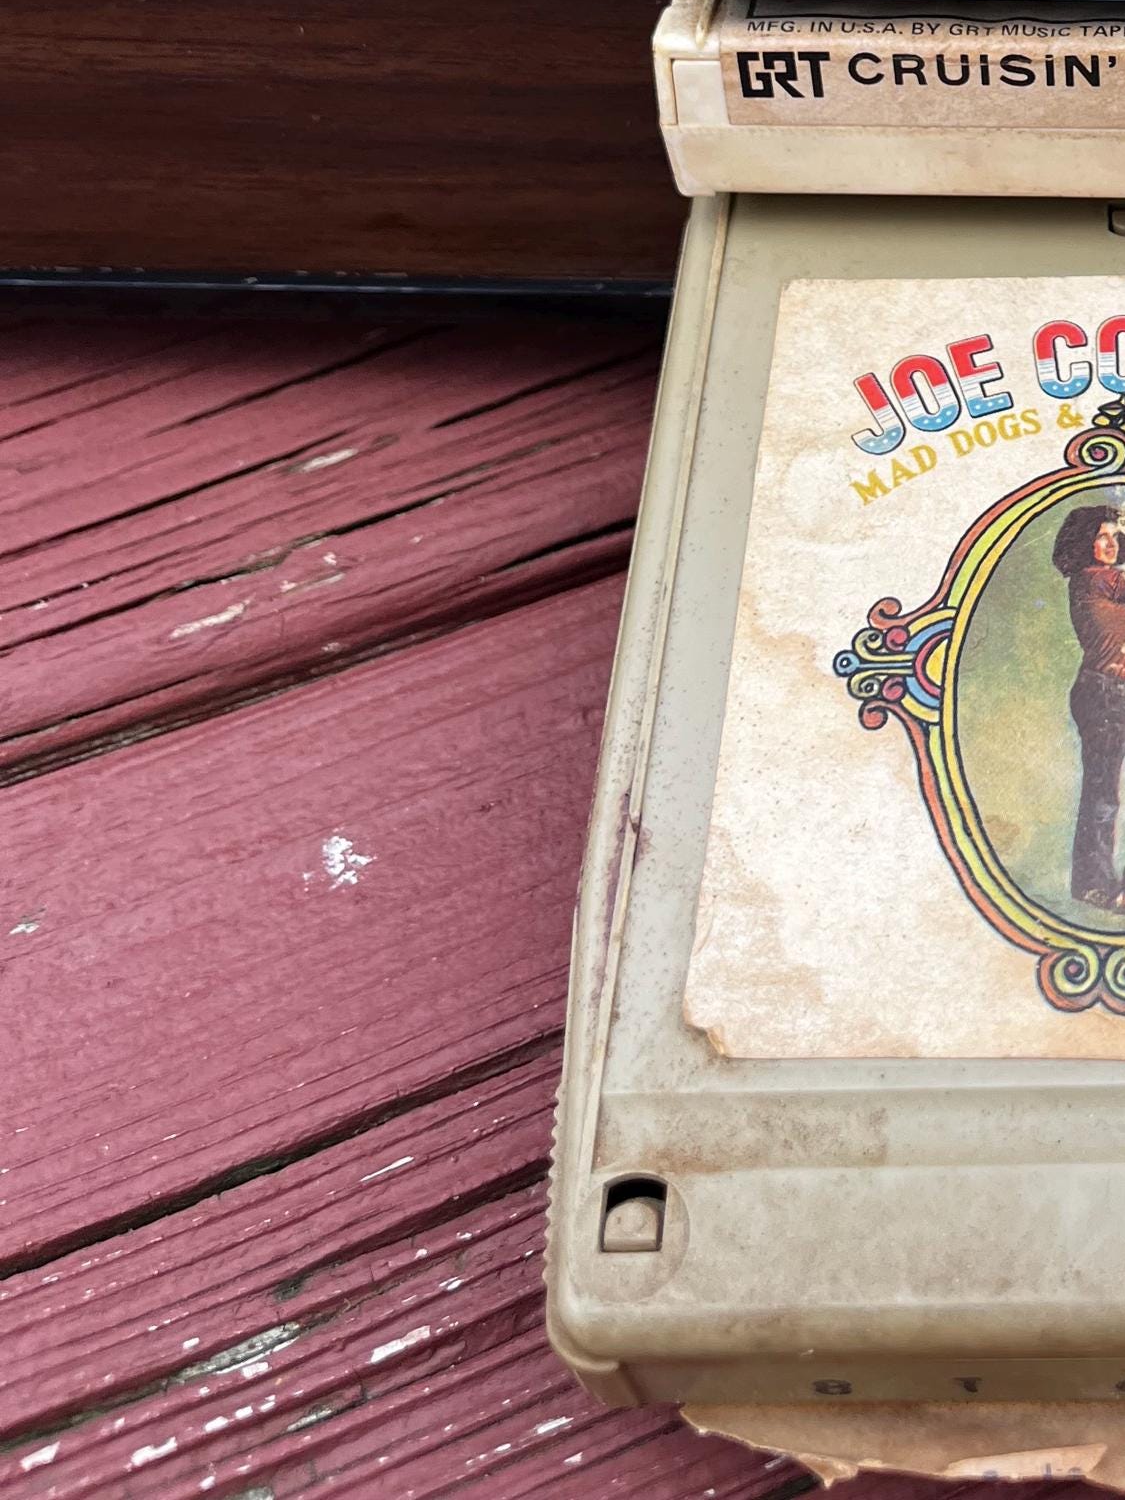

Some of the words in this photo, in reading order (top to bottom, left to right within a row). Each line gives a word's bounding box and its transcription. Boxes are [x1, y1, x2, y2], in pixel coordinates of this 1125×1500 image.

[746, 19, 801, 34] MFG.
[809, 20, 834, 34] IN
[840, 20, 904, 36] U.S.A.
[911, 21, 941, 36] BY
[948, 22, 993, 37] GRT
[1002, 23, 1072, 38] MUSIC
[735, 50, 831, 99] GRT
[850, 332, 1014, 457] JOE
[849, 442, 939, 507] MAD
[947, 404, 1043, 459] DOGS
[1055, 402, 1086, 430] &
